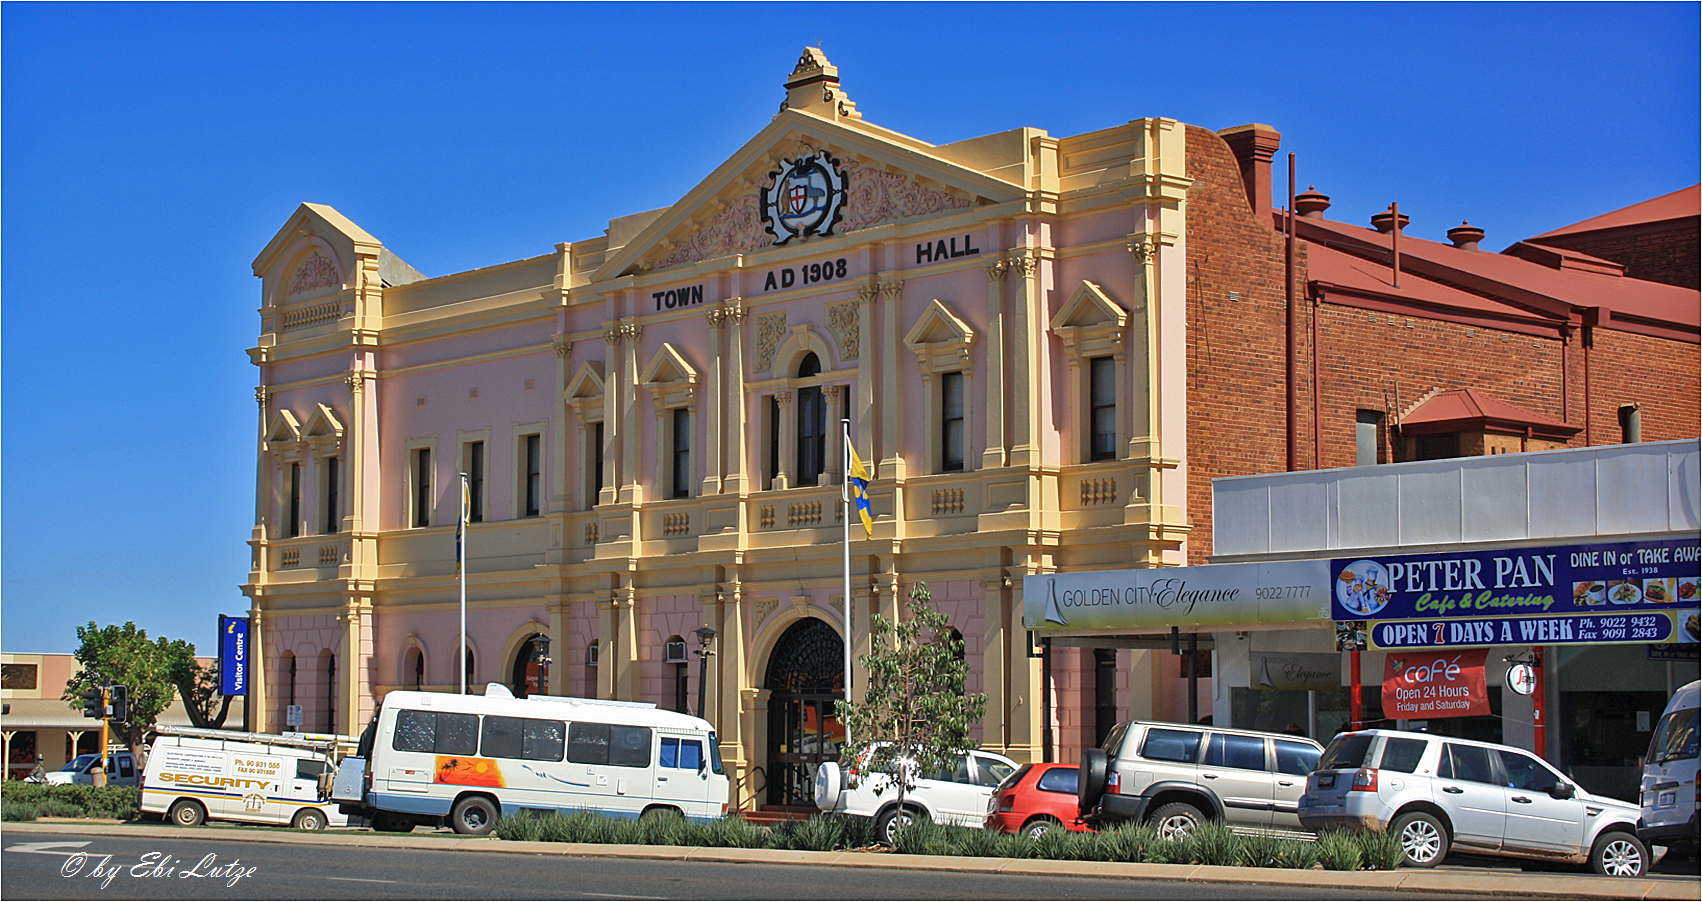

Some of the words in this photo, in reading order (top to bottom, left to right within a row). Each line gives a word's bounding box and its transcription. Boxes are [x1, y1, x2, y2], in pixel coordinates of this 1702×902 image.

[916, 235, 980, 264] HALL
[802, 258, 847, 285] 1908
[652, 284, 704, 311] TOWN
[1570, 551, 1600, 568] DINE
[1603, 550, 1616, 566] IN
[1620, 552, 1633, 565] or
[1637, 547, 1670, 564] TAKE
[1641, 566, 1658, 574] 1938
[1386, 558, 1486, 594] PETER
[1493, 554, 1557, 589] PAN
[1062, 588, 1120, 608] GOLDEN
[1125, 587, 1155, 605] CITY
[1151, 578, 1240, 616] Elegance
[1255, 587, 1282, 600] 9022
[1286, 585, 1312, 599] 7777
[1415, 592, 1456, 614] Cafe
[1459, 592, 1473, 609] &
[1475, 590, 1555, 611] Catering
[1382, 623, 1428, 645] OPEN
[1432, 622, 1446, 645] 7
[1450, 621, 1494, 643] DAYS
[1500, 621, 1514, 642] A
[1519, 618, 1574, 641] WEEK
[1578, 629, 1597, 639] Fax
[1602, 628, 1626, 639] 9091
[1631, 627, 1658, 638] 2843
[1579, 618, 1596, 629] Ph.
[1600, 617, 1626, 628] 9022
[1630, 616, 1656, 627] 9432
[235, 632, 244, 661] Centre
[234, 662, 244, 691] Visitor
[1283, 663, 1332, 685] Elegance
[1404, 654, 1462, 683] café
[1396, 686, 1421, 701] Open
[1423, 685, 1437, 698] 24
[1438, 685, 1470, 697] Hours
[1396, 702, 1419, 713] Friday
[1420, 701, 1434, 711] and
[1435, 700, 1471, 711] Saturday
[159, 772, 271, 790] SECURITY
